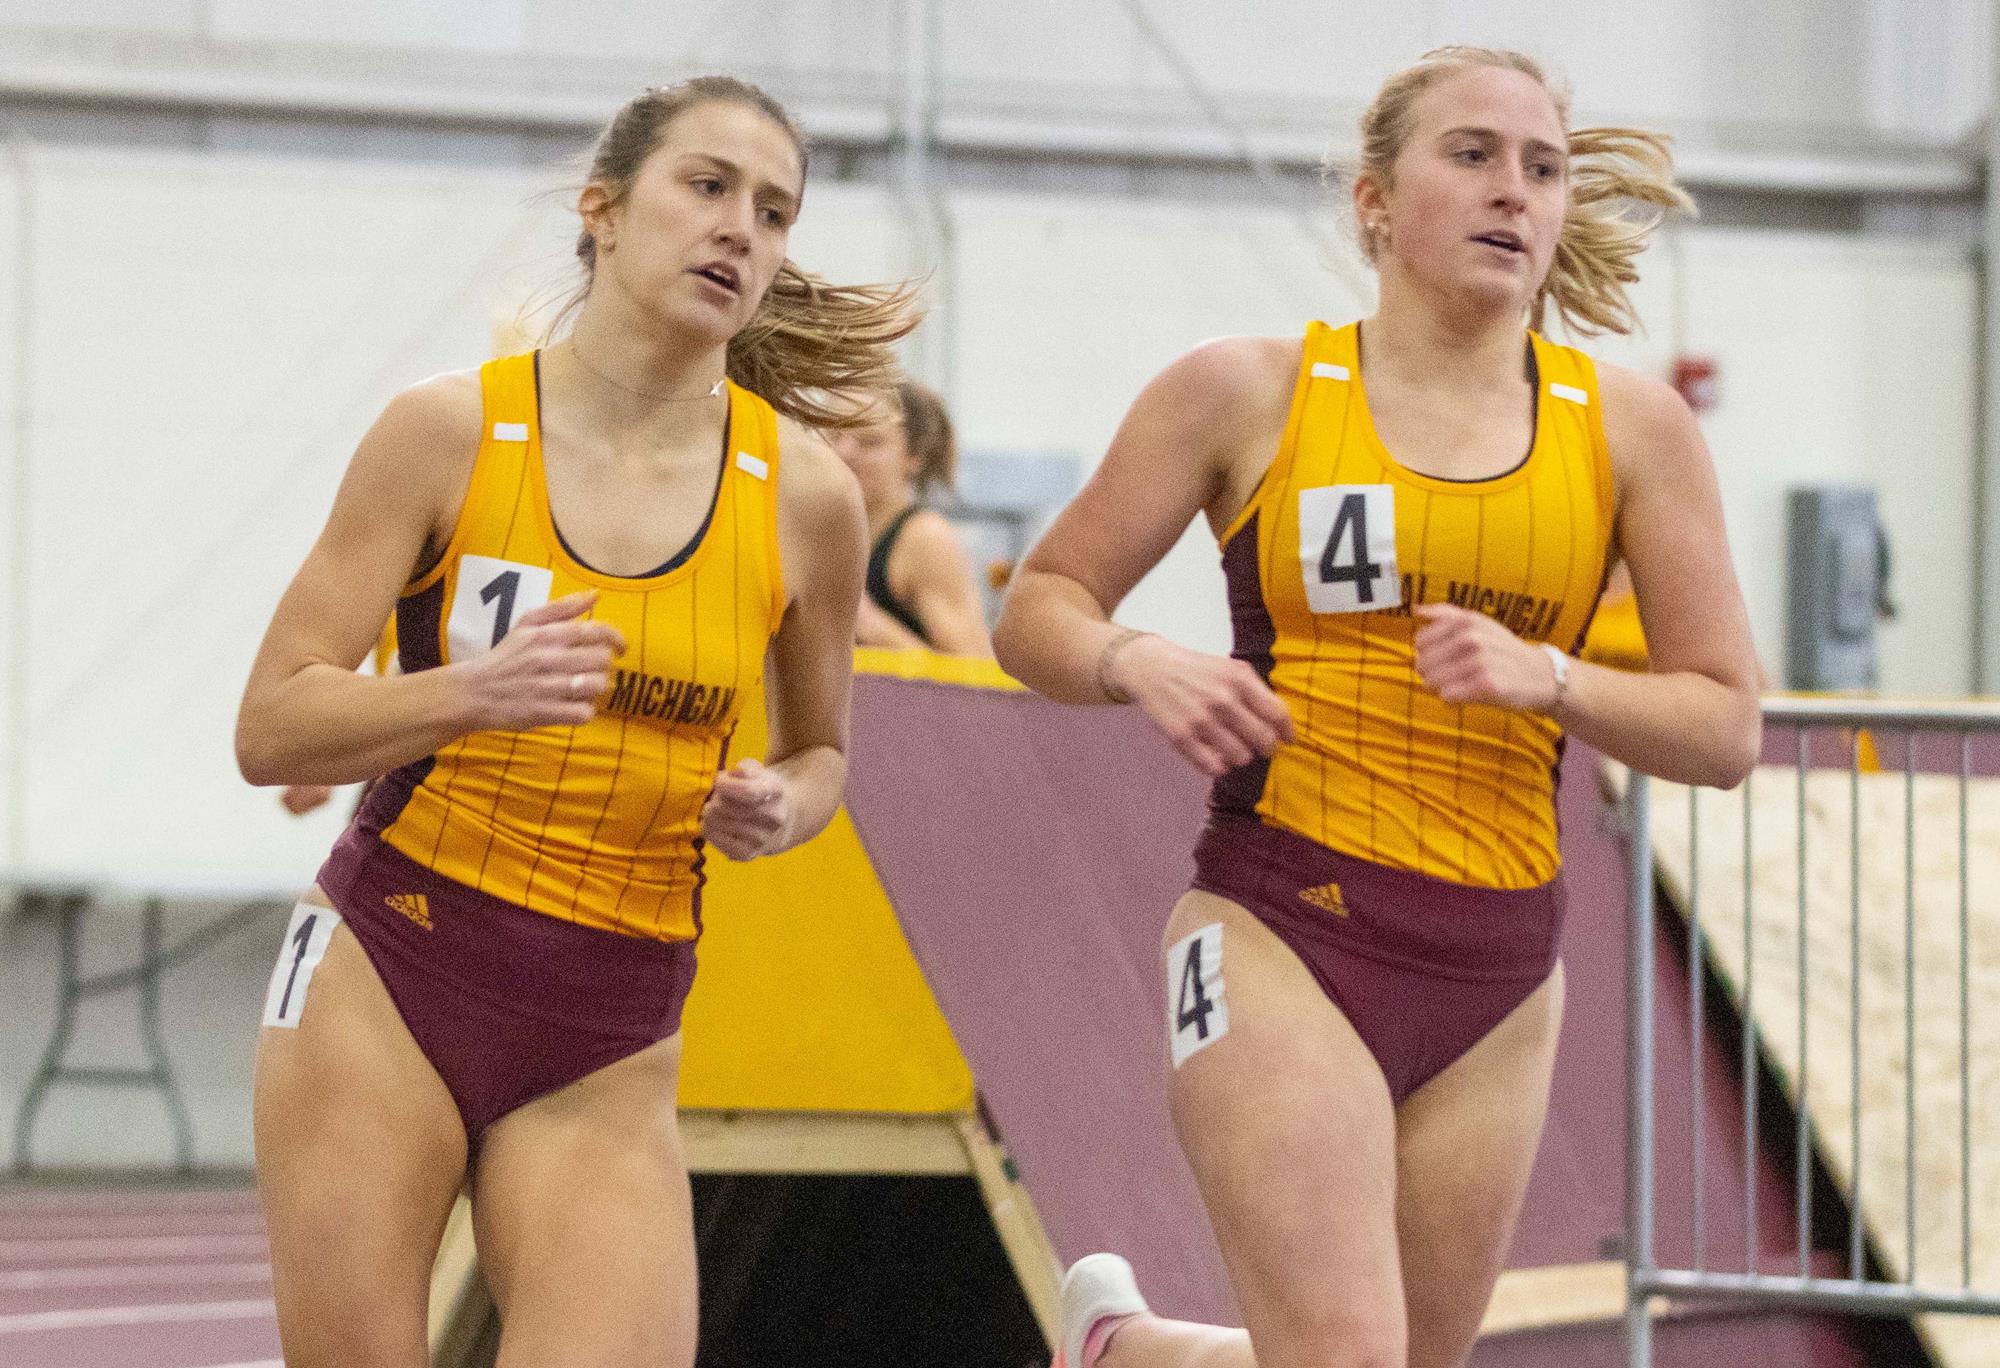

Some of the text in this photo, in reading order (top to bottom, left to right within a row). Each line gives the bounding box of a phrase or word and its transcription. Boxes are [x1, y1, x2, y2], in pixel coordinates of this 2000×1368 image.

[1318, 494, 1381, 603] 4
[479, 569, 521, 651] 1
[1447, 580, 1565, 641] MICHIGAN
[608, 669, 736, 727] MICHIGAN
[278, 913, 318, 1020] 1
[1177, 936, 1214, 1041] 4
